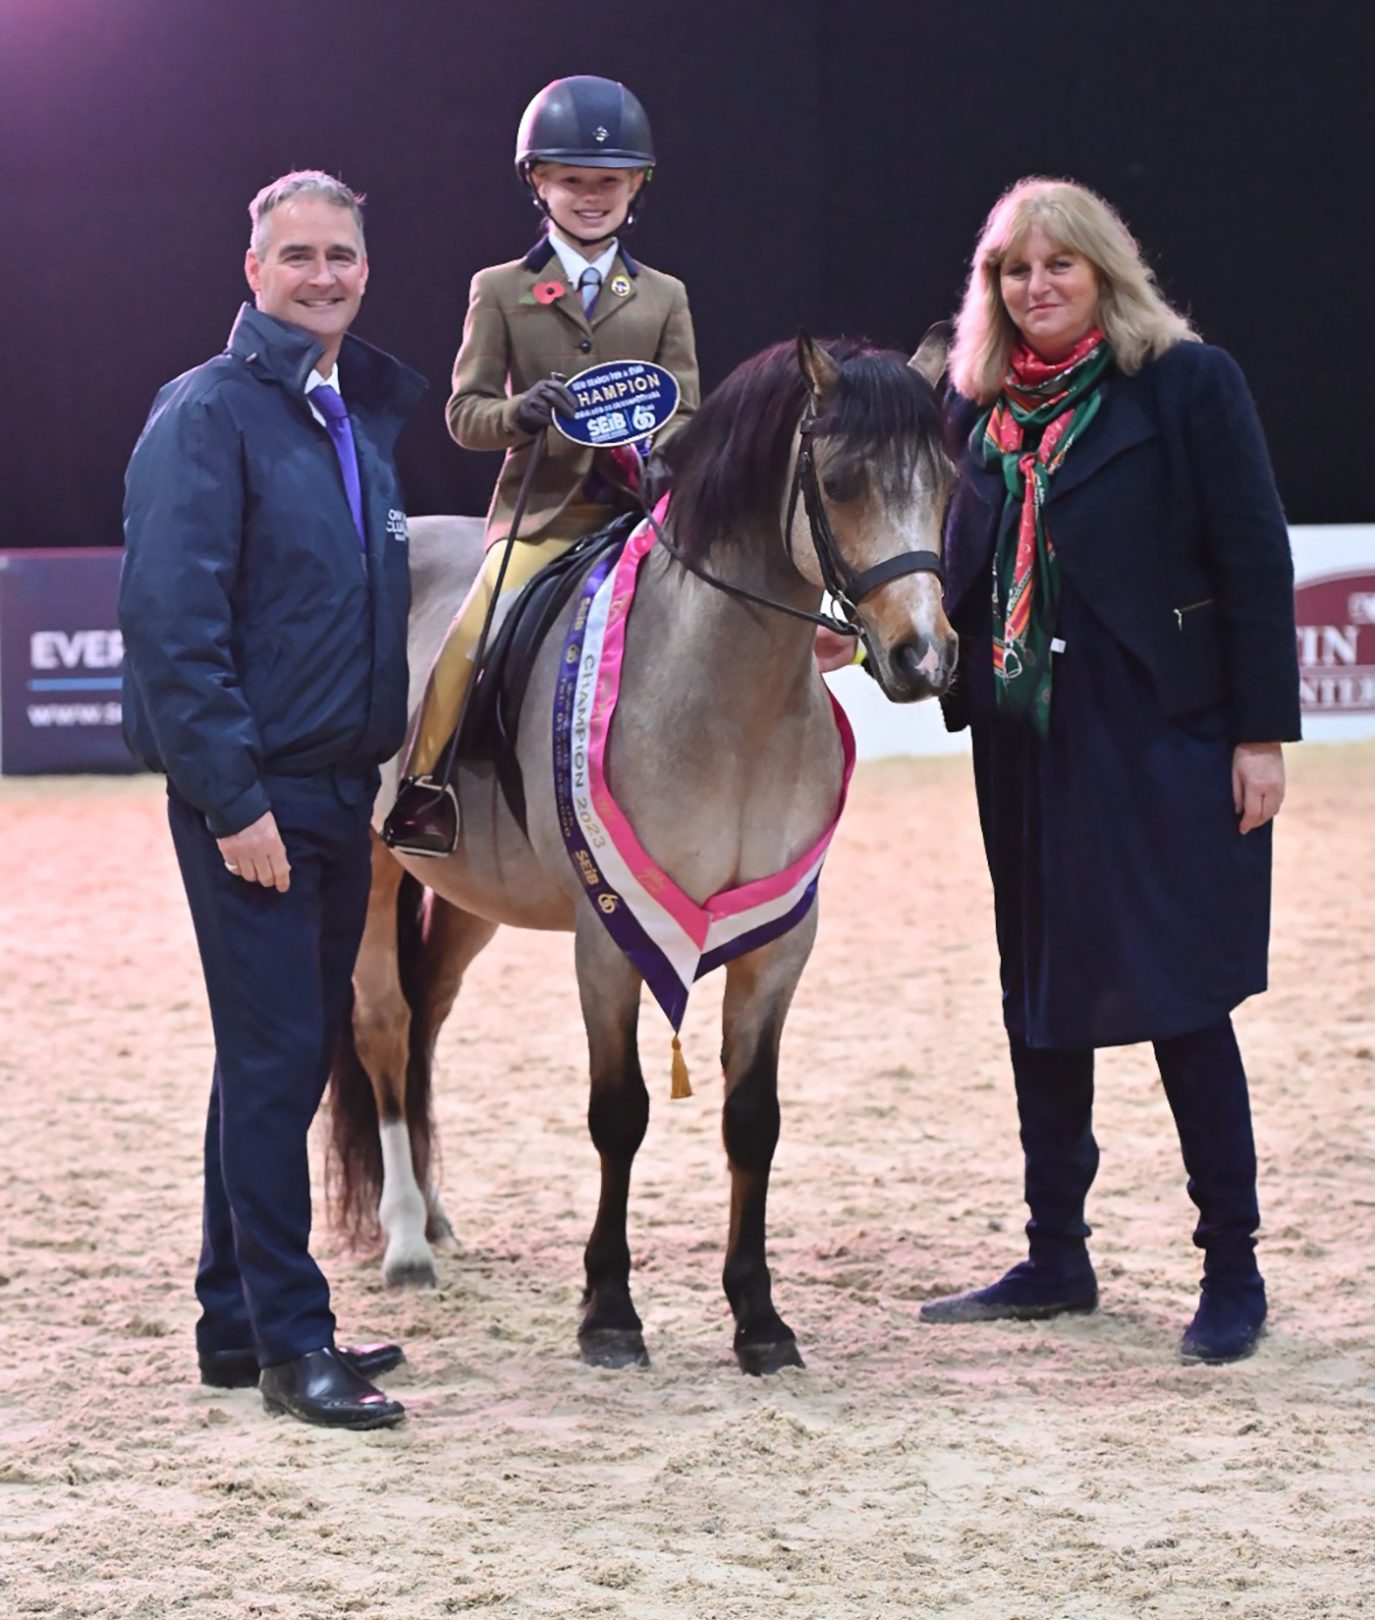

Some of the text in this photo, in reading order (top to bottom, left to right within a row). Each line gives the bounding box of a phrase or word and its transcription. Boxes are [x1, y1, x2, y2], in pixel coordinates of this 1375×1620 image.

[577, 373, 661, 407] HAMPION
[574, 654, 596, 788] CHAMPION
[575, 797, 606, 849] 2023
